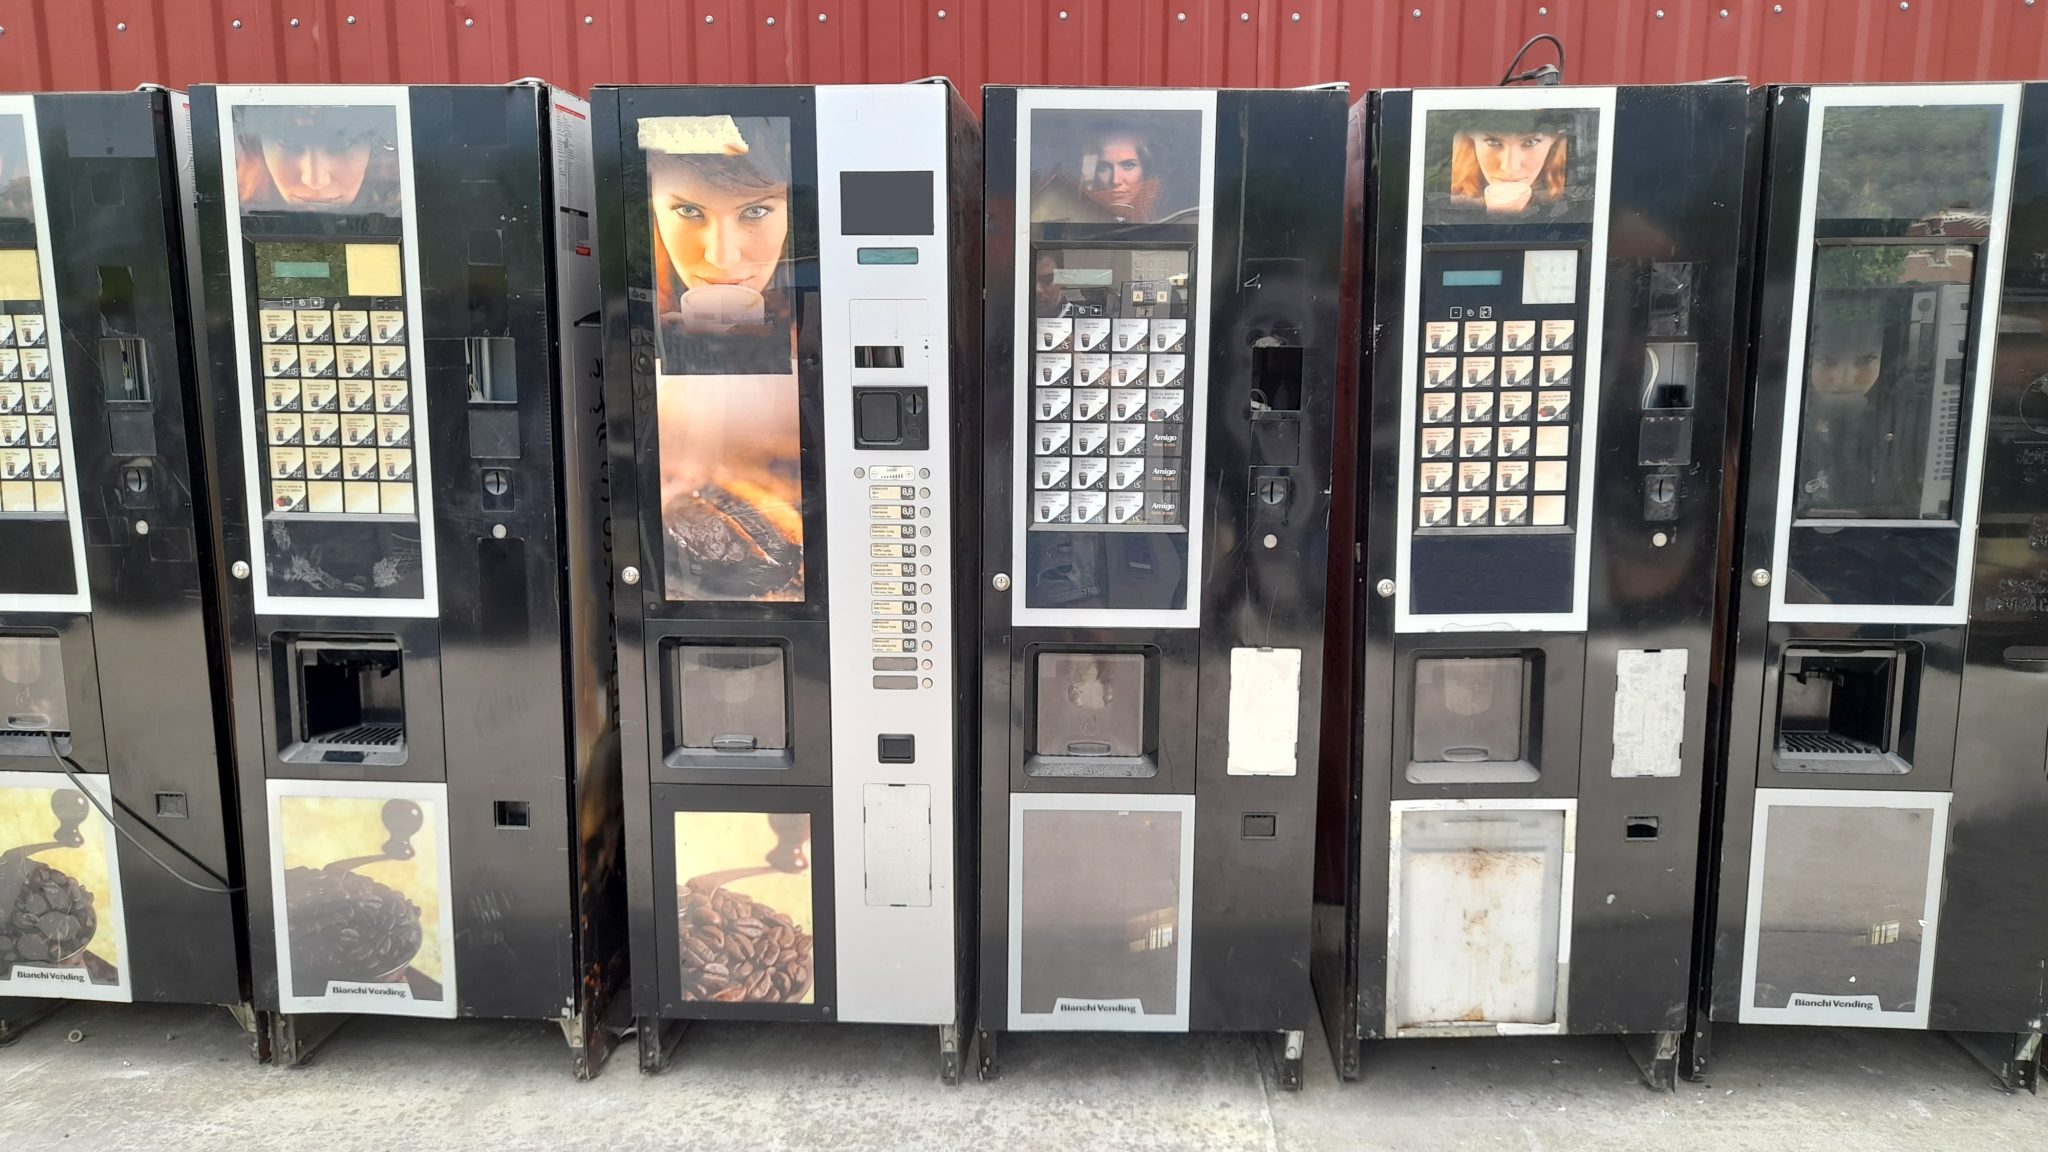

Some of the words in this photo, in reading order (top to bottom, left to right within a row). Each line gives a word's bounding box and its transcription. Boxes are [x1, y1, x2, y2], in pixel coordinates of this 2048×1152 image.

[1153, 434, 1177, 442] Amigo
[1152, 468, 1176, 476] Amigo
[1152, 502, 1175, 511] Amigo
[17, 971, 49, 980] Bianchi
[50, 972, 84, 982] Vending
[368, 987, 406, 997] Vending
[1097, 1004, 1136, 1014] Vending
[1795, 999, 1831, 1007] Bianchi
[1833, 1000, 1873, 1010] Vending
